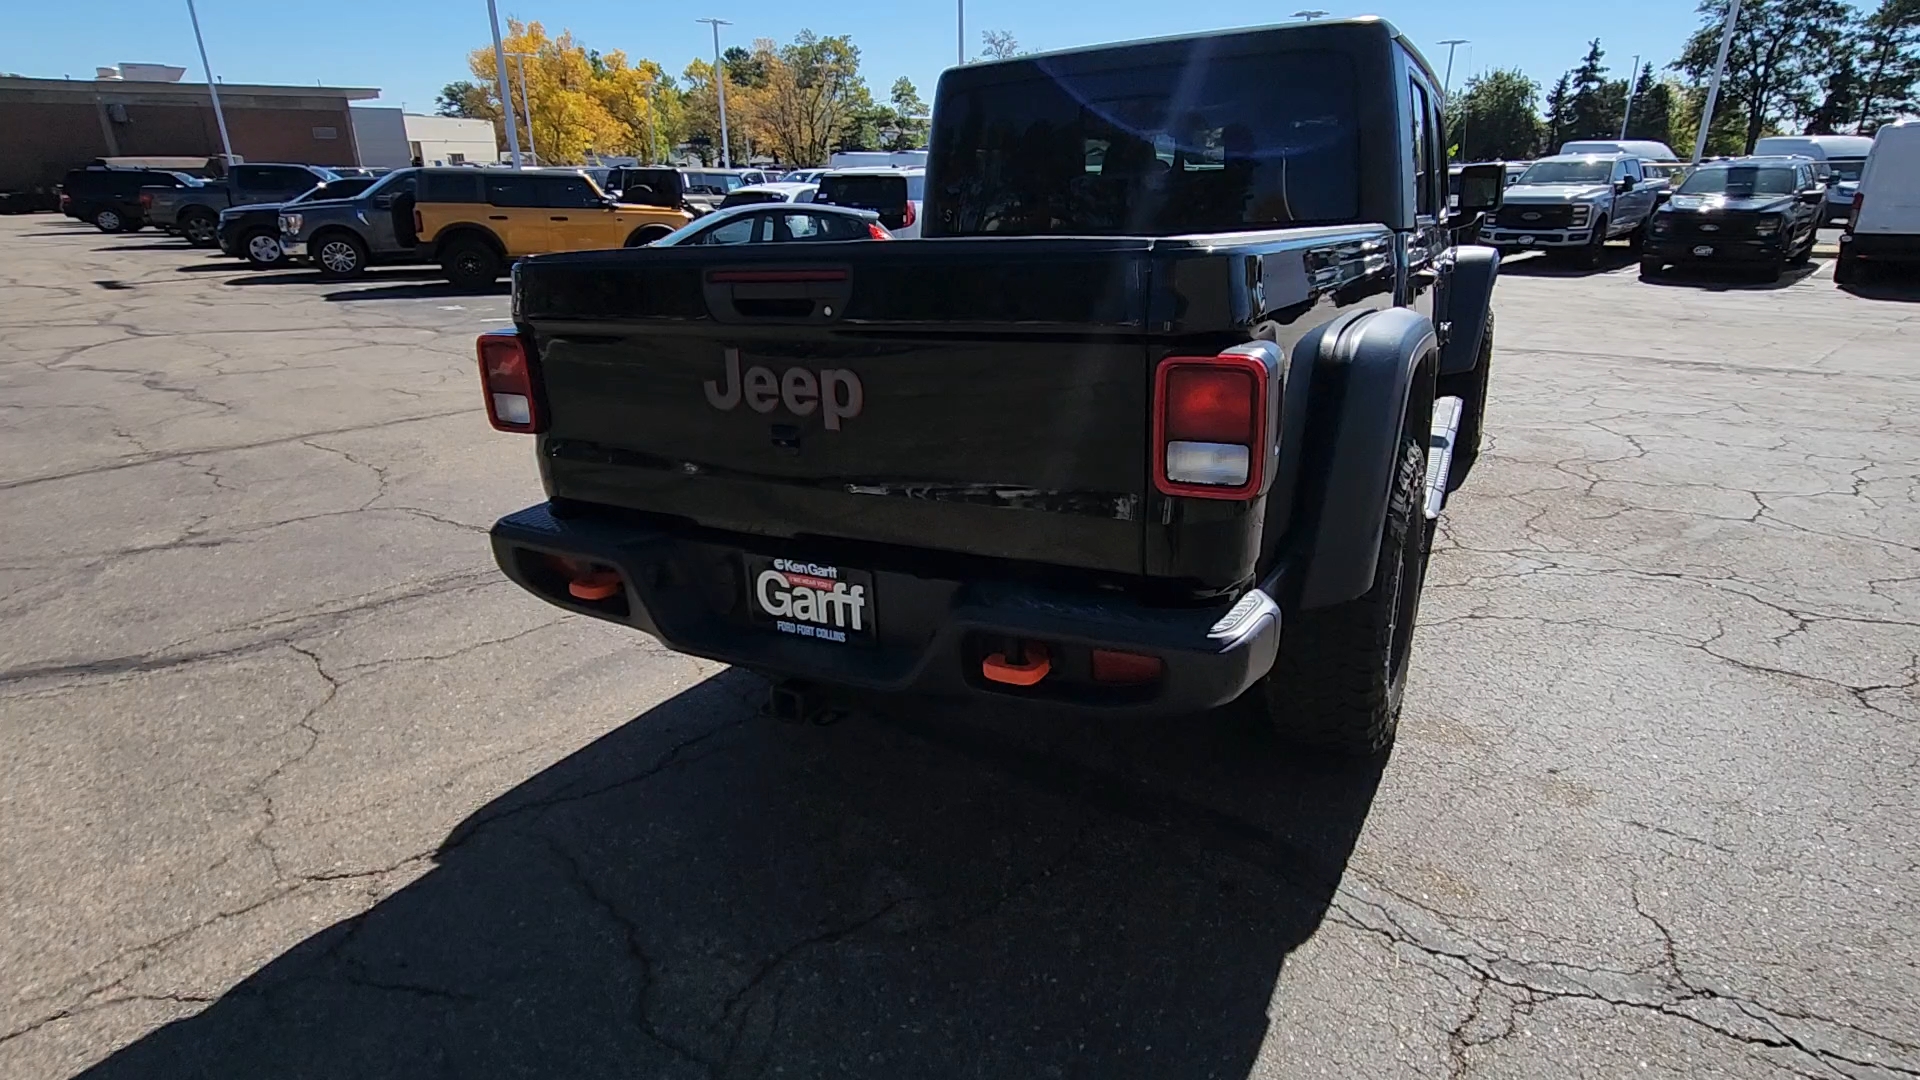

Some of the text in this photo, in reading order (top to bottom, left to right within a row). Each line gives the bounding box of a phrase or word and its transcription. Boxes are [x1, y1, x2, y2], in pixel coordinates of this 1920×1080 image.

[703, 347, 863, 431] Jeep
[784, 559, 837, 579] Ken Garff
[757, 569, 865, 630] Garff
[777, 620, 846, 643] FORD FORT COLLINS
